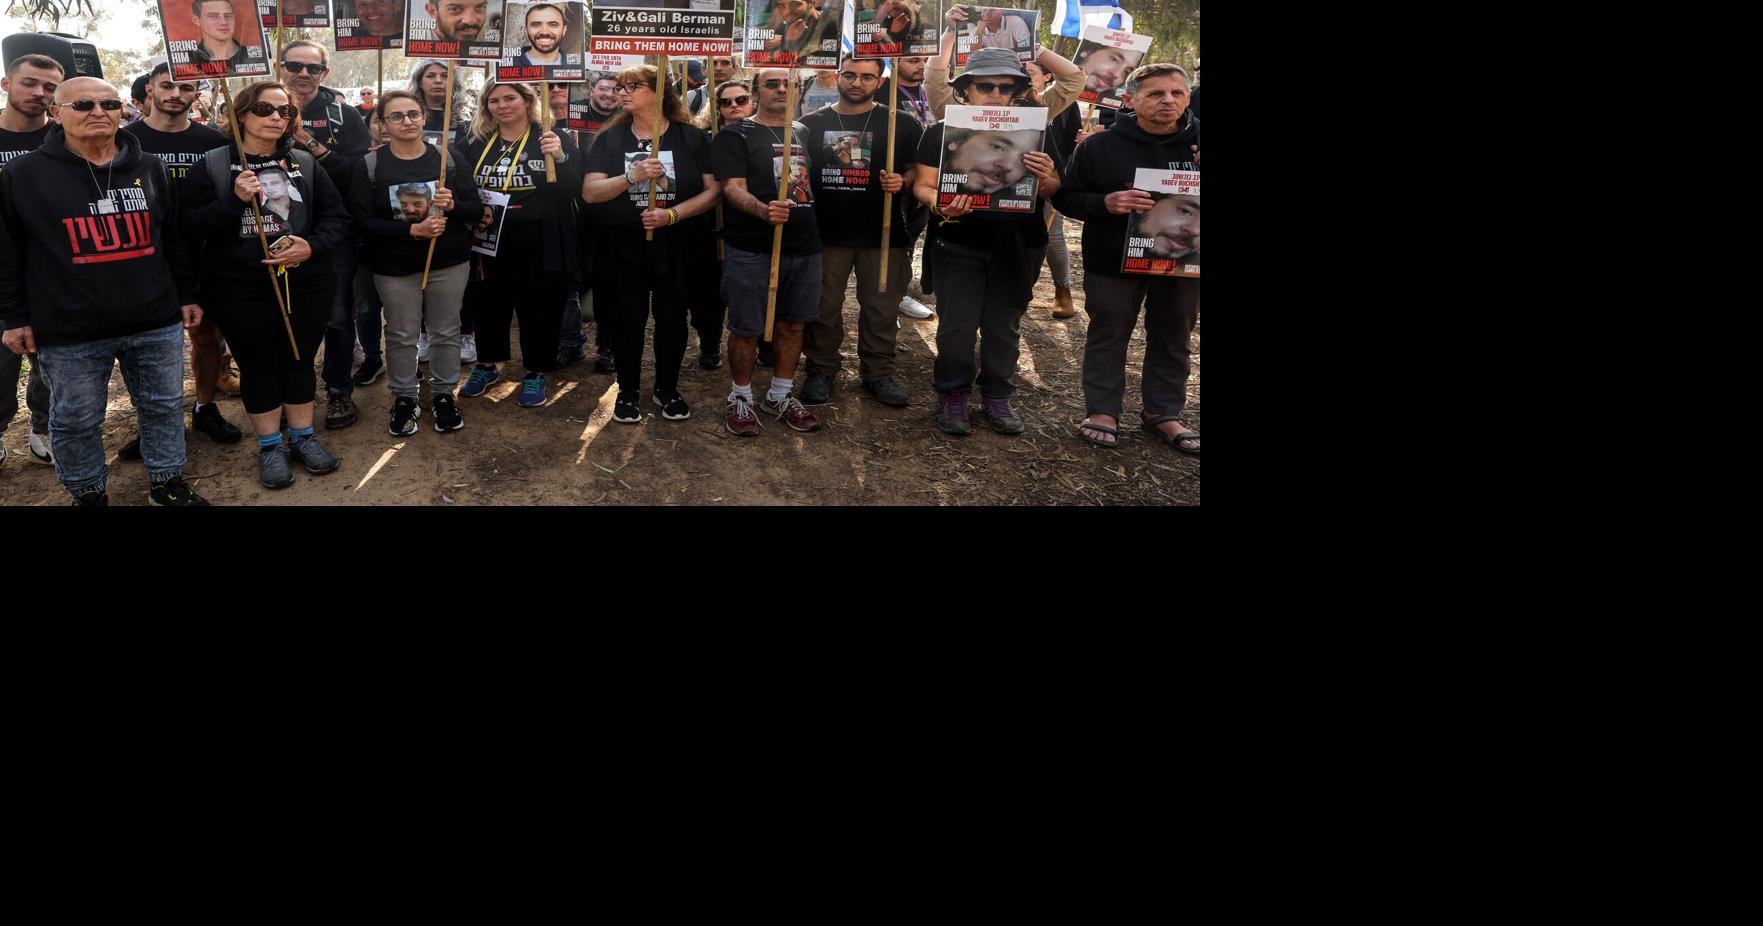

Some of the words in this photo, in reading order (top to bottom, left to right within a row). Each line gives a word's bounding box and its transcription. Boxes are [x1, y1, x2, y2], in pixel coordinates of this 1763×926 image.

[337, 18, 360, 27] BRING
[602, 11, 666, 23] Ziv&Gali
[672, 13, 726, 24] Berman
[410, 18, 436, 29] BRING
[857, 24, 880, 33] BRING
[338, 28, 352, 37] HIM
[410, 30, 426, 40] HIM
[625, 26, 655, 34] years
[660, 26, 677, 34] old
[681, 26, 720, 34] Israelis
[748, 29, 774, 39] BRING
[337, 37, 359, 47] HOME
[362, 36, 383, 47] NOW!
[857, 34, 872, 42] HIM
[958, 36, 978, 45] BRING
[169, 40, 197, 52] BRING
[409, 41, 433, 52] HOME
[435, 41, 460, 53] NOW!
[595, 41, 630, 50] BRING
[634, 41, 664, 51] THEM
[668, 42, 699, 51] HOME
[702, 42, 729, 52] NOW!
[748, 40, 764, 50] HIM
[856, 43, 879, 53] HOME
[881, 41, 902, 53] NOW!
[503, 47, 521, 57] RING
[748, 51, 771, 62] HOME
[172, 52, 189, 63] HIM
[174, 63, 200, 75] HOME
[201, 60, 228, 73] NOW!
[499, 67, 520, 77] HOME
[523, 66, 544, 76] NOW!
[569, 104, 588, 112] BRING
[942, 174, 968, 184] BRING
[941, 184, 957, 193] HIM
[242, 215, 274, 224] HOSAGE
[253, 224, 280, 233] HMAS
[1129, 237, 1154, 248] BRING
[1128, 248, 1144, 257] HIM
[1126, 258, 1149, 268] HOME
[1152, 258, 1176, 270] NOW!
